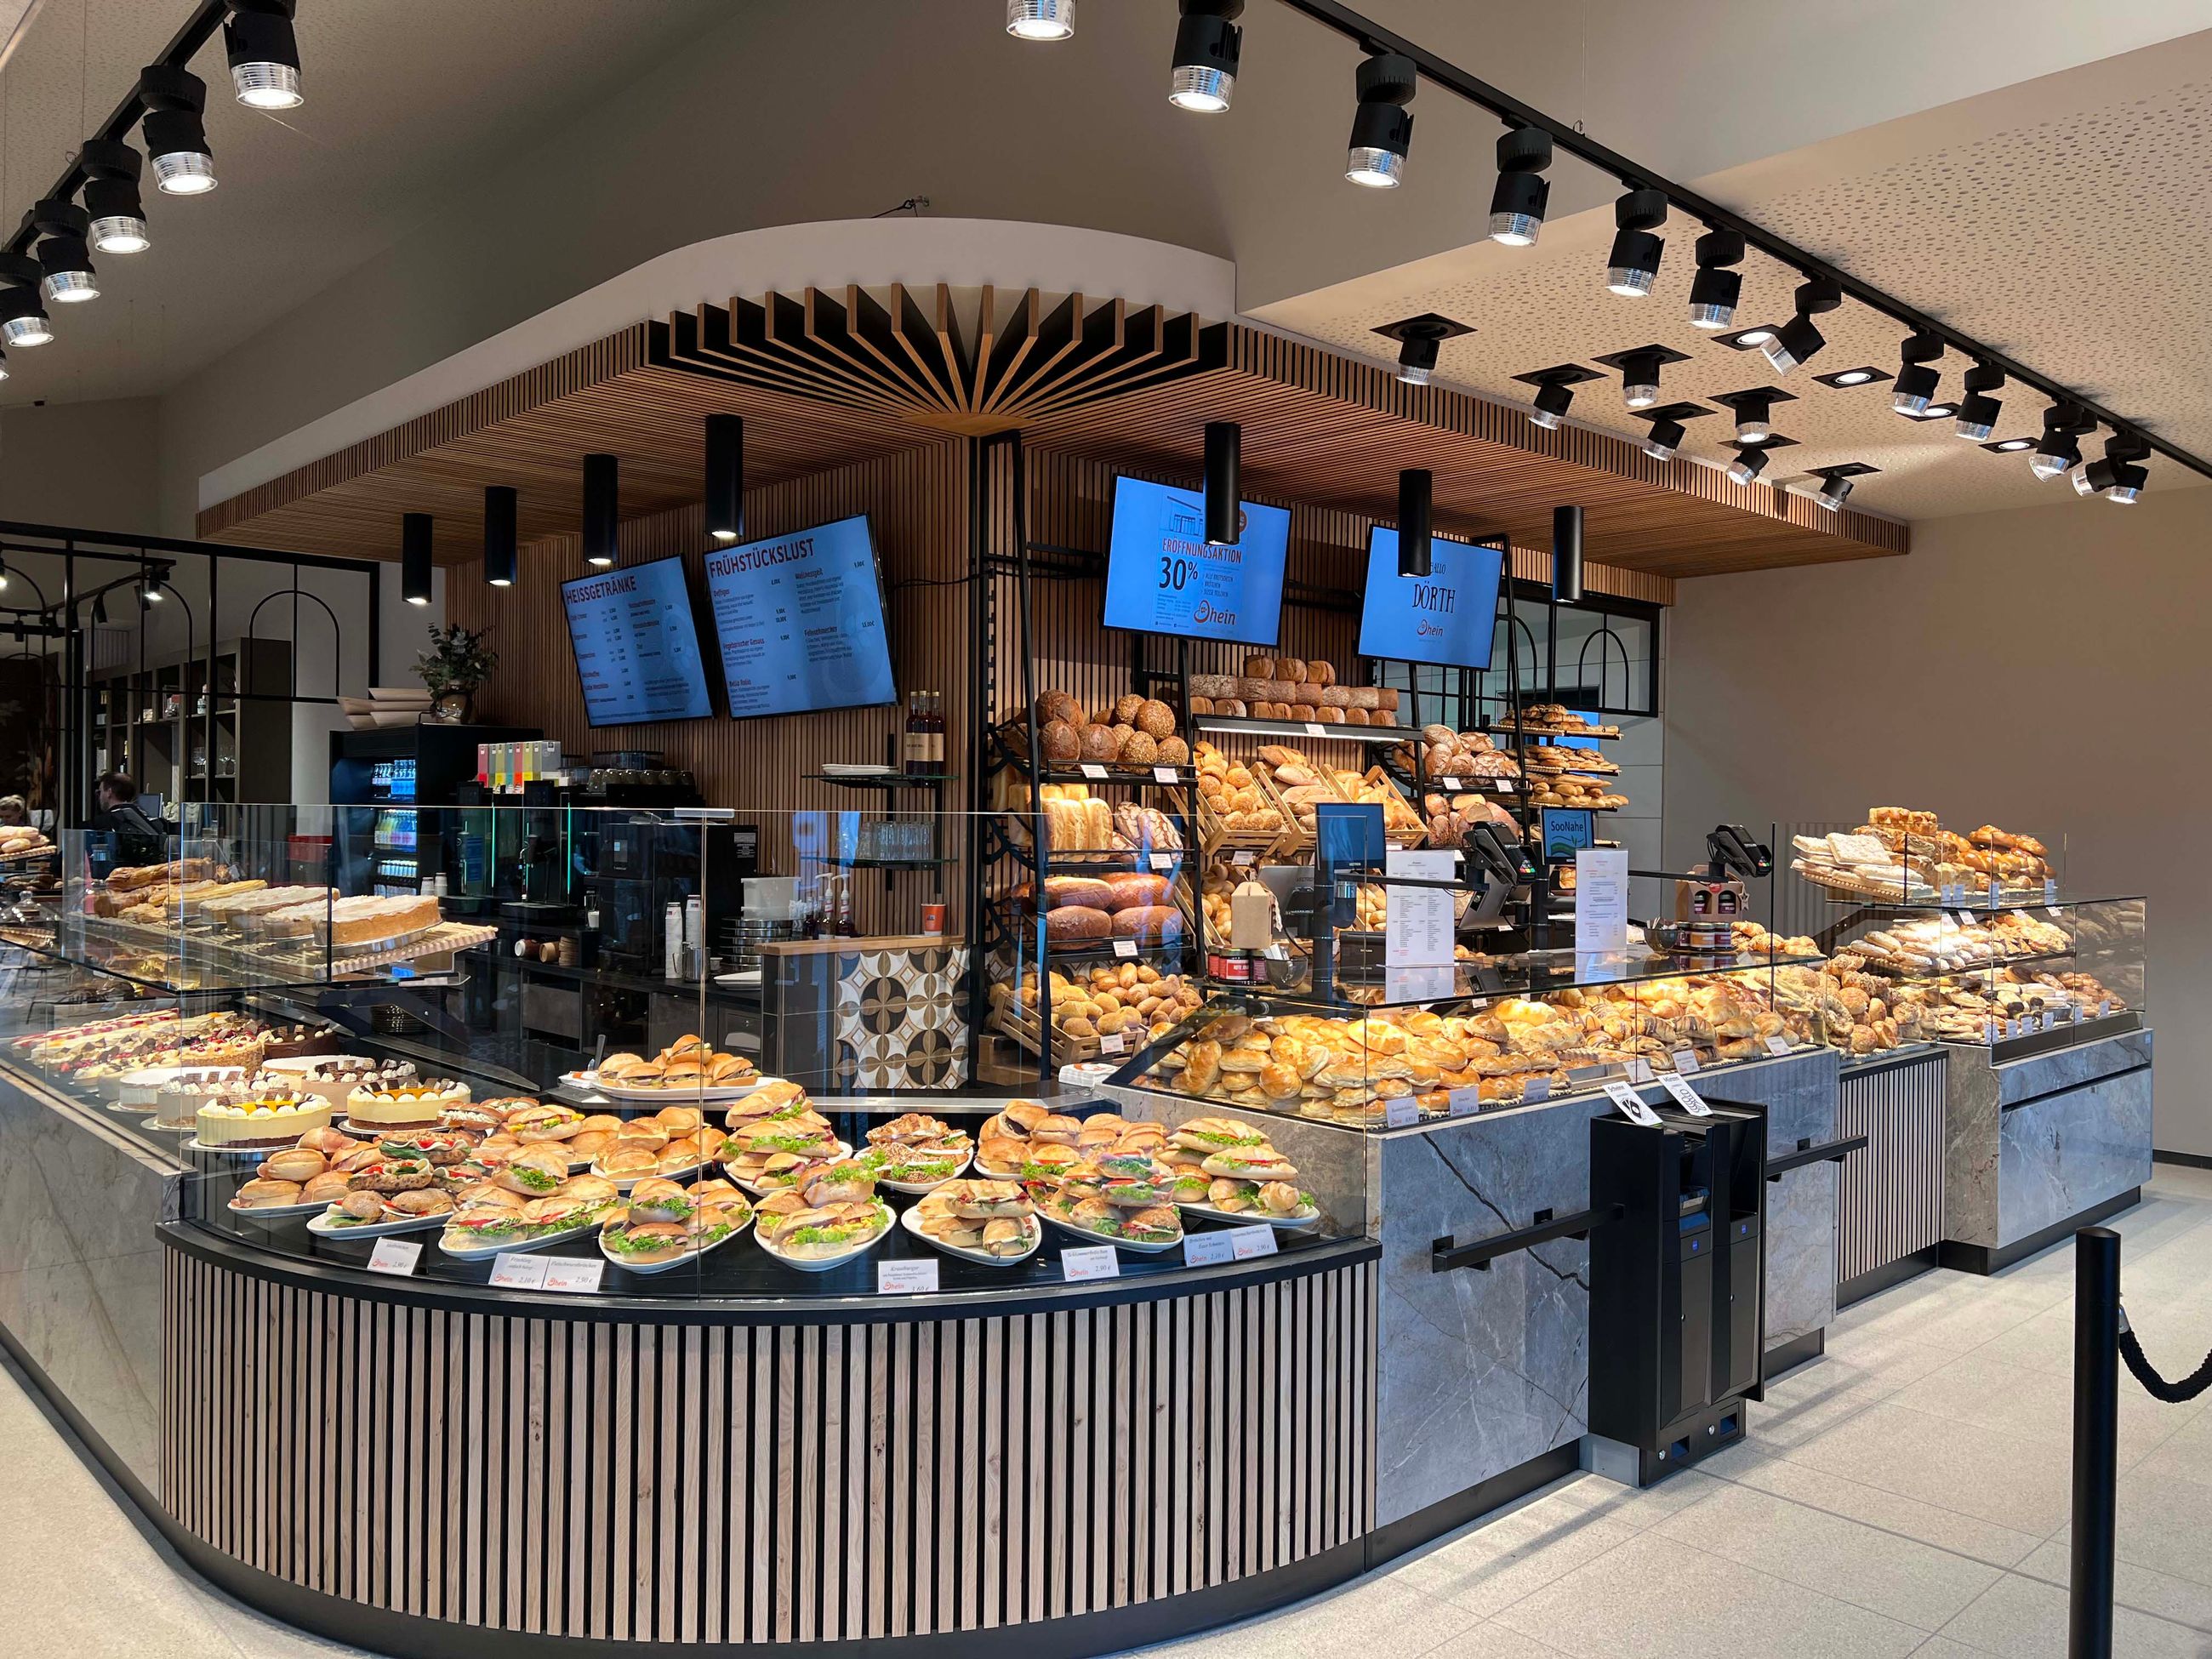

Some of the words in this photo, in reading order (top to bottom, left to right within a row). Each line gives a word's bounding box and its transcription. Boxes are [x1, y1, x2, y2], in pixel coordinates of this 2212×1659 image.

[710, 538, 813, 579] FRÜHSTÜCKSLUST
[1162, 536, 1242, 563] ERÖFFNUNGSAKTION
[1159, 556, 1198, 590] 30%
[566, 575, 637, 605] HEISSGETRÄNKE
[1412, 580, 1456, 613] DÖRTH
[1551, 821, 1583, 831] SooNahe
